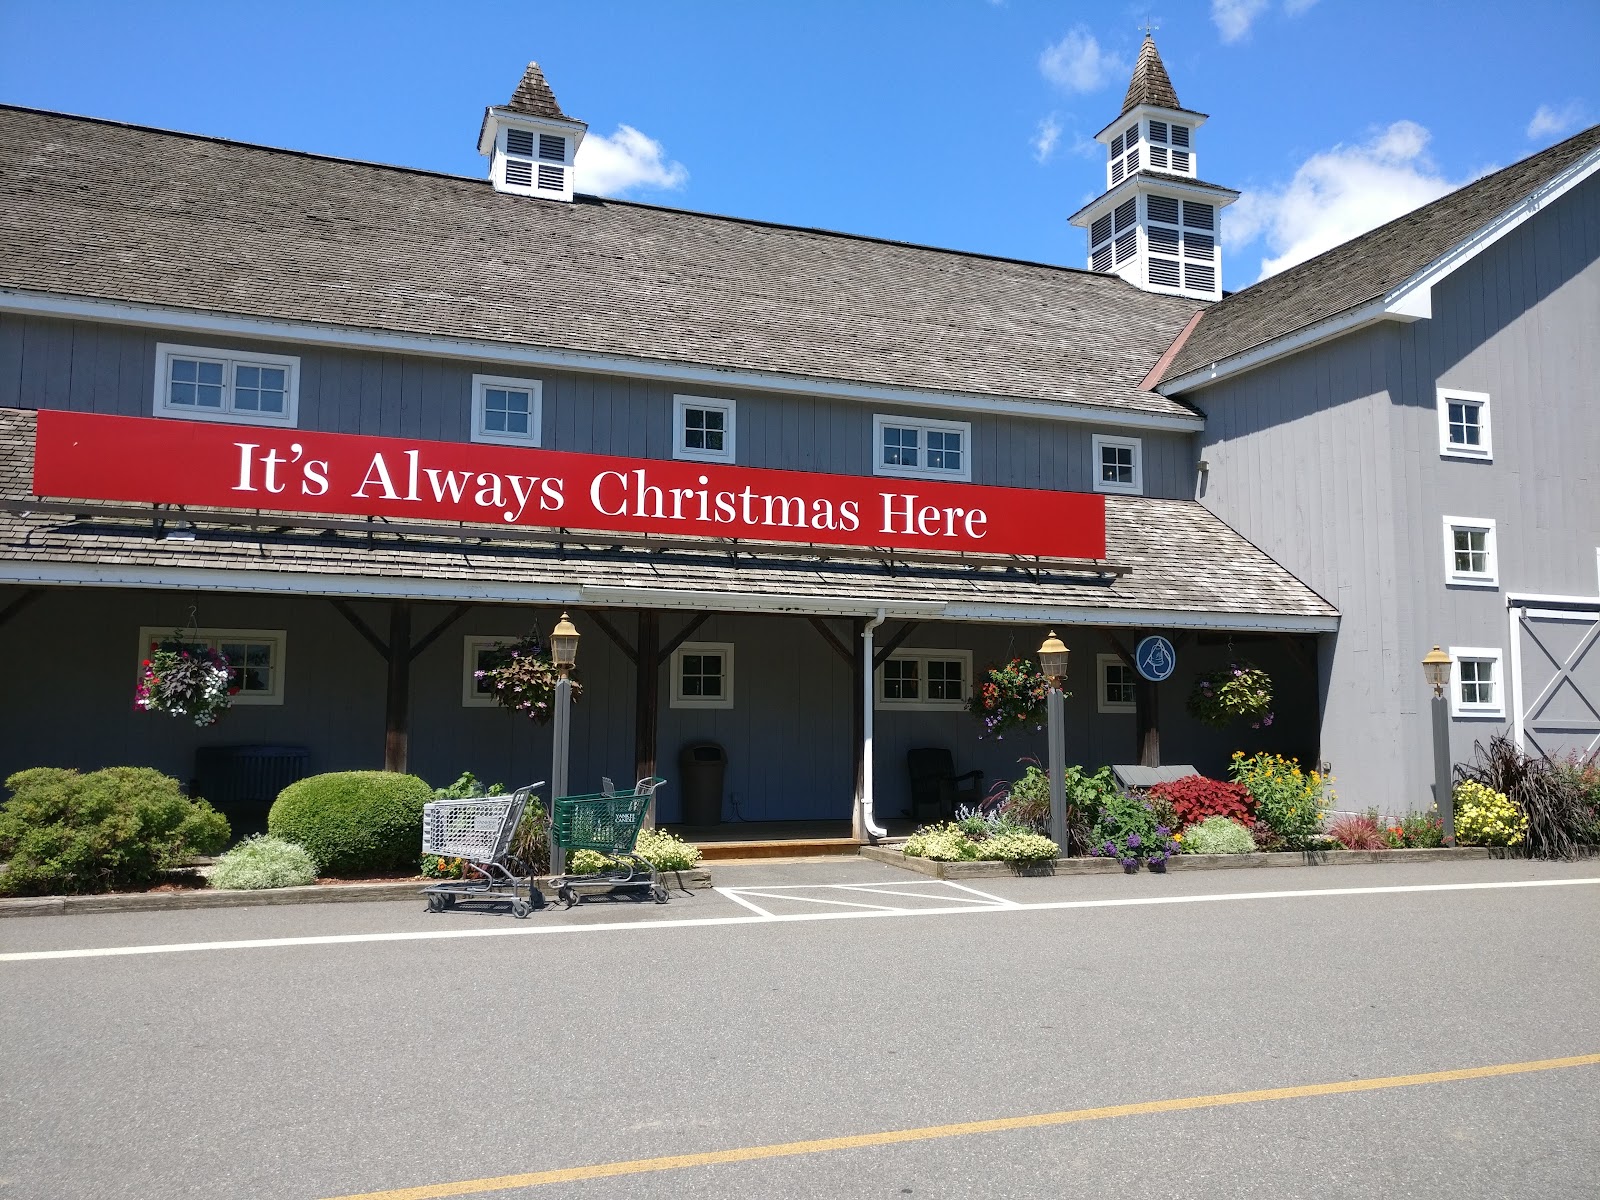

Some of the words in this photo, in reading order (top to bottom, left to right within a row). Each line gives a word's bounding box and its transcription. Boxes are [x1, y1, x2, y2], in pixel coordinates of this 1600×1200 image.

[231, 442, 329, 496] It's
[350, 449, 566, 524] Always
[589, 468, 862, 533] Christmas
[878, 492, 988, 540] Here
